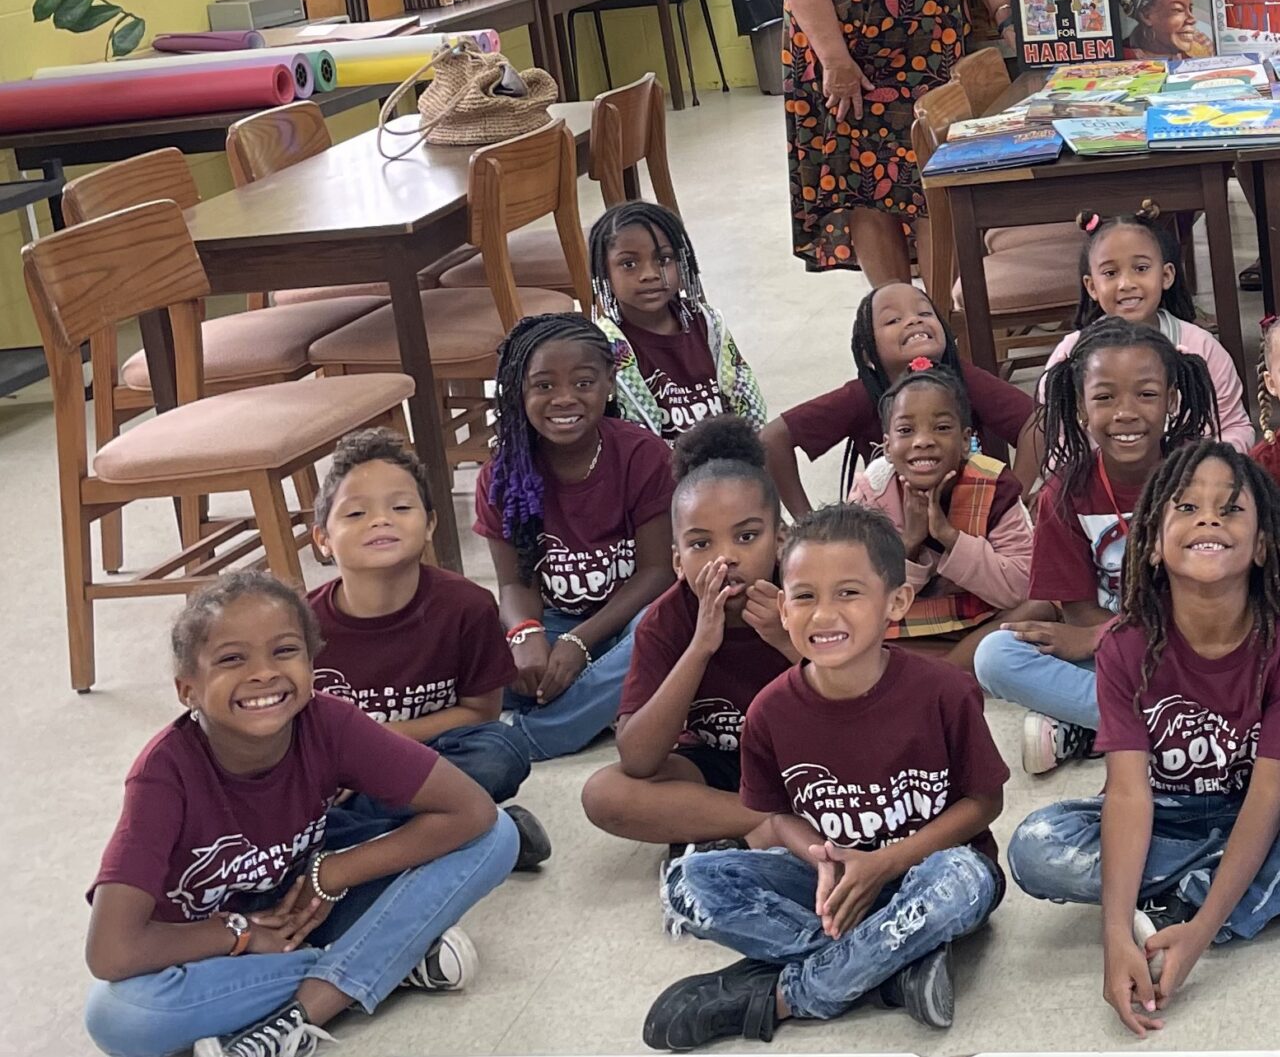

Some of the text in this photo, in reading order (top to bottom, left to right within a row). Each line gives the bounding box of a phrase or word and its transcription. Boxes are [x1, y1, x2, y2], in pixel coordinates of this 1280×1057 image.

[1061, 18, 1070, 27] IS
[1057, 28, 1076, 38] FOR
[1023, 39, 1115, 64] HARLEM
[548, 552, 593, 563] PEARL
[578, 561, 587, 571] K
[383, 687, 399, 697] B.
[358, 700, 369, 709] K
[386, 699, 396, 708] 8
[816, 768, 949, 798] PEARL B. LARSEN
[814, 796, 845, 810] PRE
[849, 796, 860, 808] K
[876, 794, 887, 806] 8
[892, 778, 951, 798] SCHOOL
[236, 855, 286, 883] PRE K
